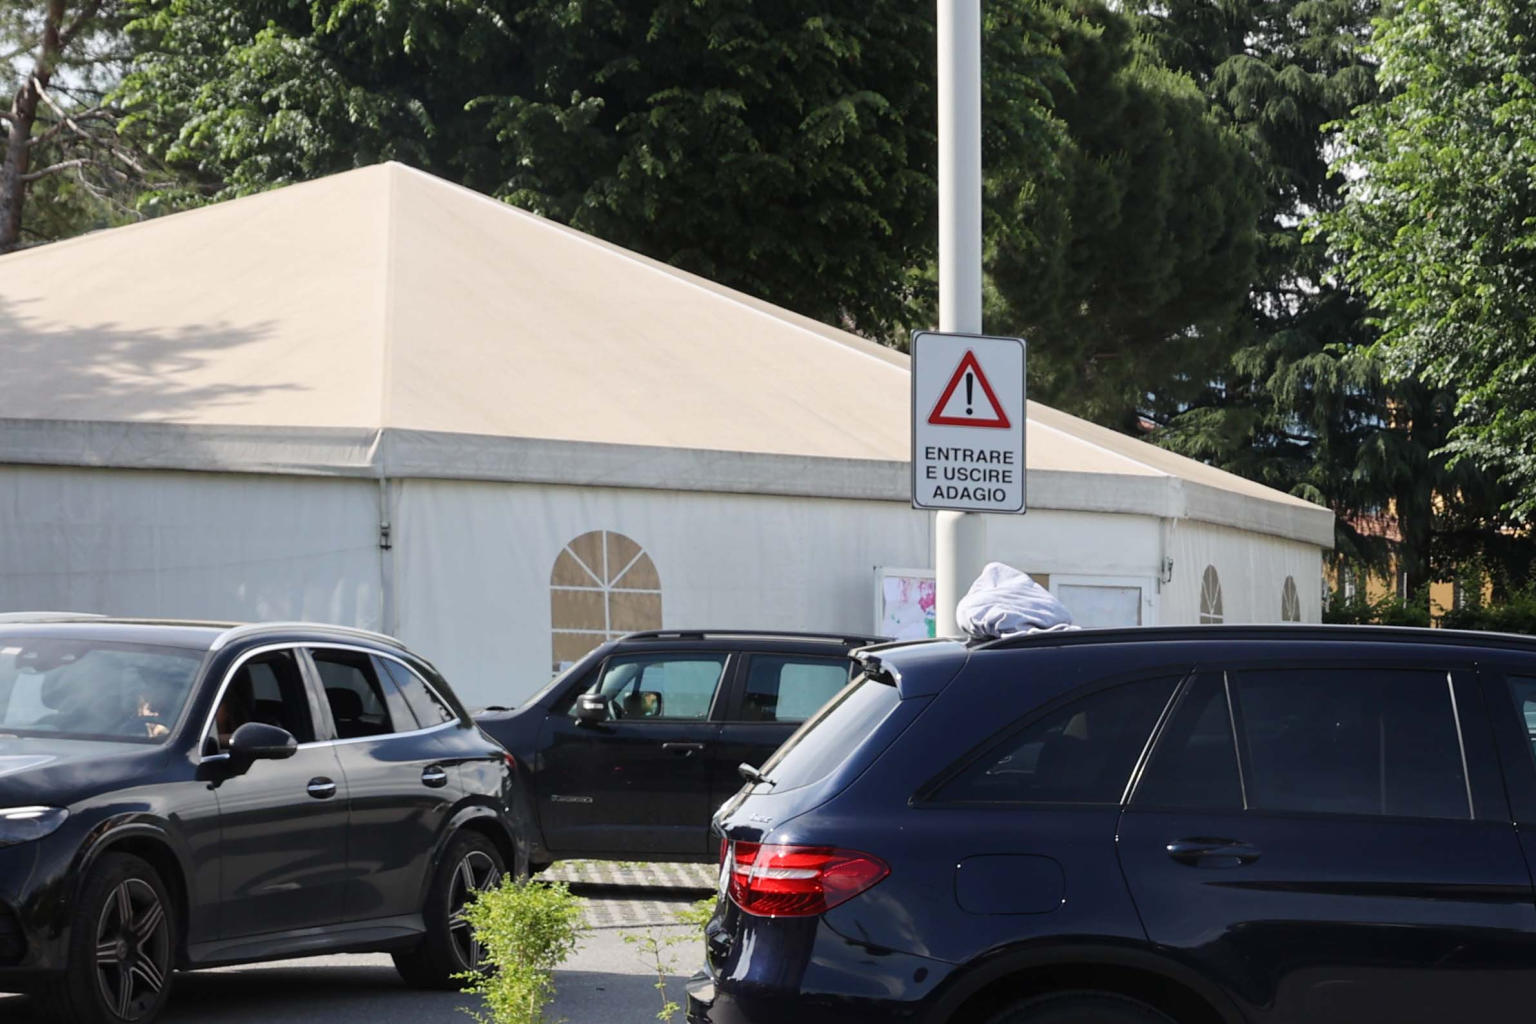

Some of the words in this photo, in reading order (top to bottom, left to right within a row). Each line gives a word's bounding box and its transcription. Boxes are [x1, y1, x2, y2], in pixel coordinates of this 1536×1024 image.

[925, 446, 1014, 465] ENTRARE
[926, 466, 937, 480] E
[944, 466, 1013, 484] USCIRE
[933, 486, 1006, 502] ADAGIO
